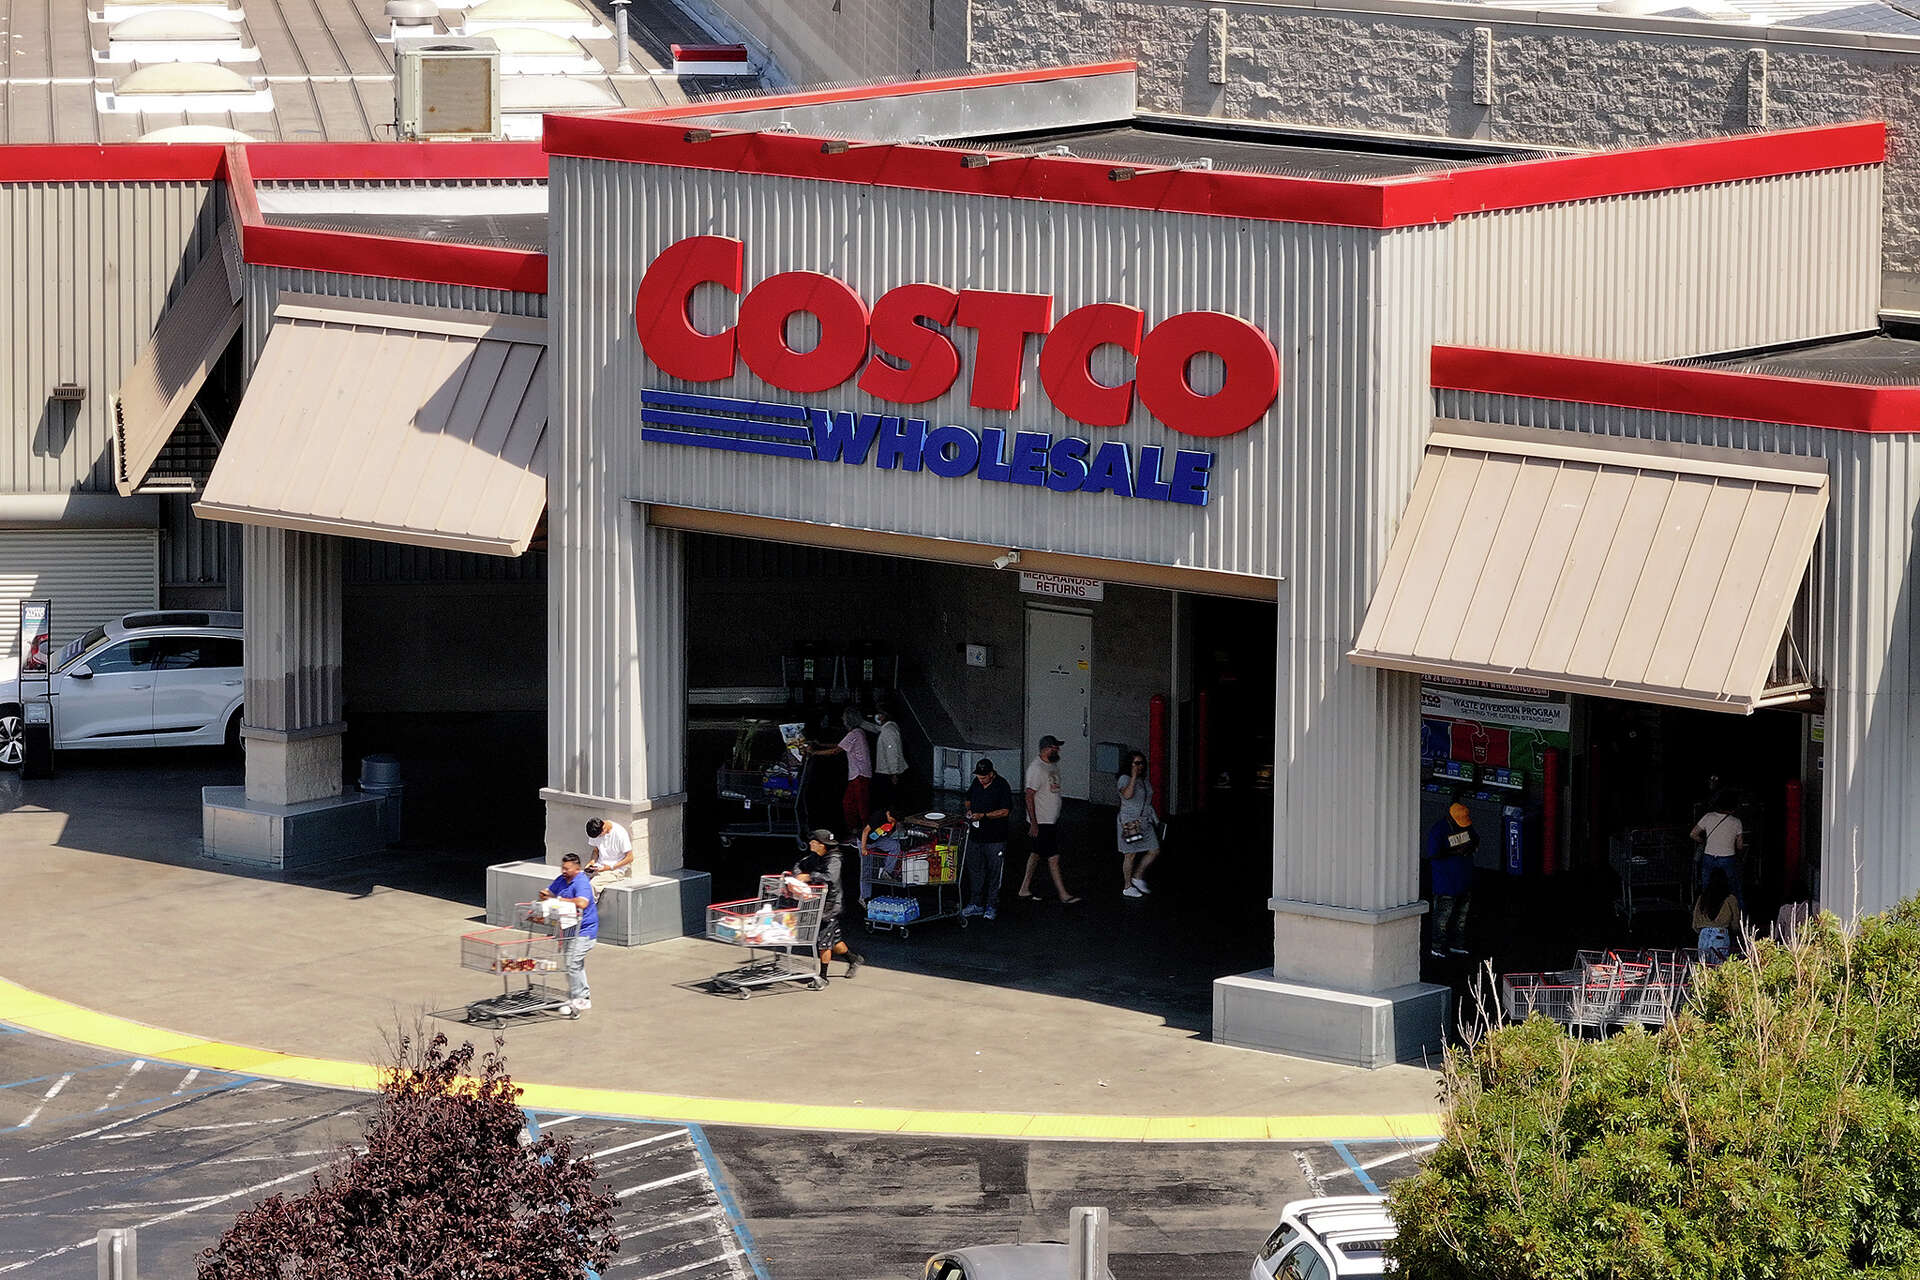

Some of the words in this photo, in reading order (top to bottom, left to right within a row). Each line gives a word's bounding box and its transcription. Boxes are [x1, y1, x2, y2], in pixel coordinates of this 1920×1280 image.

[636, 235, 1280, 437] COSTCO
[809, 406, 1215, 506] WHOLESALE
[1036, 581, 1086, 596] RETURNS
[1453, 698, 1479, 710] WASTE
[1479, 702, 1520, 715] DIVERSION
[1521, 706, 1561, 719] PROGRAM
